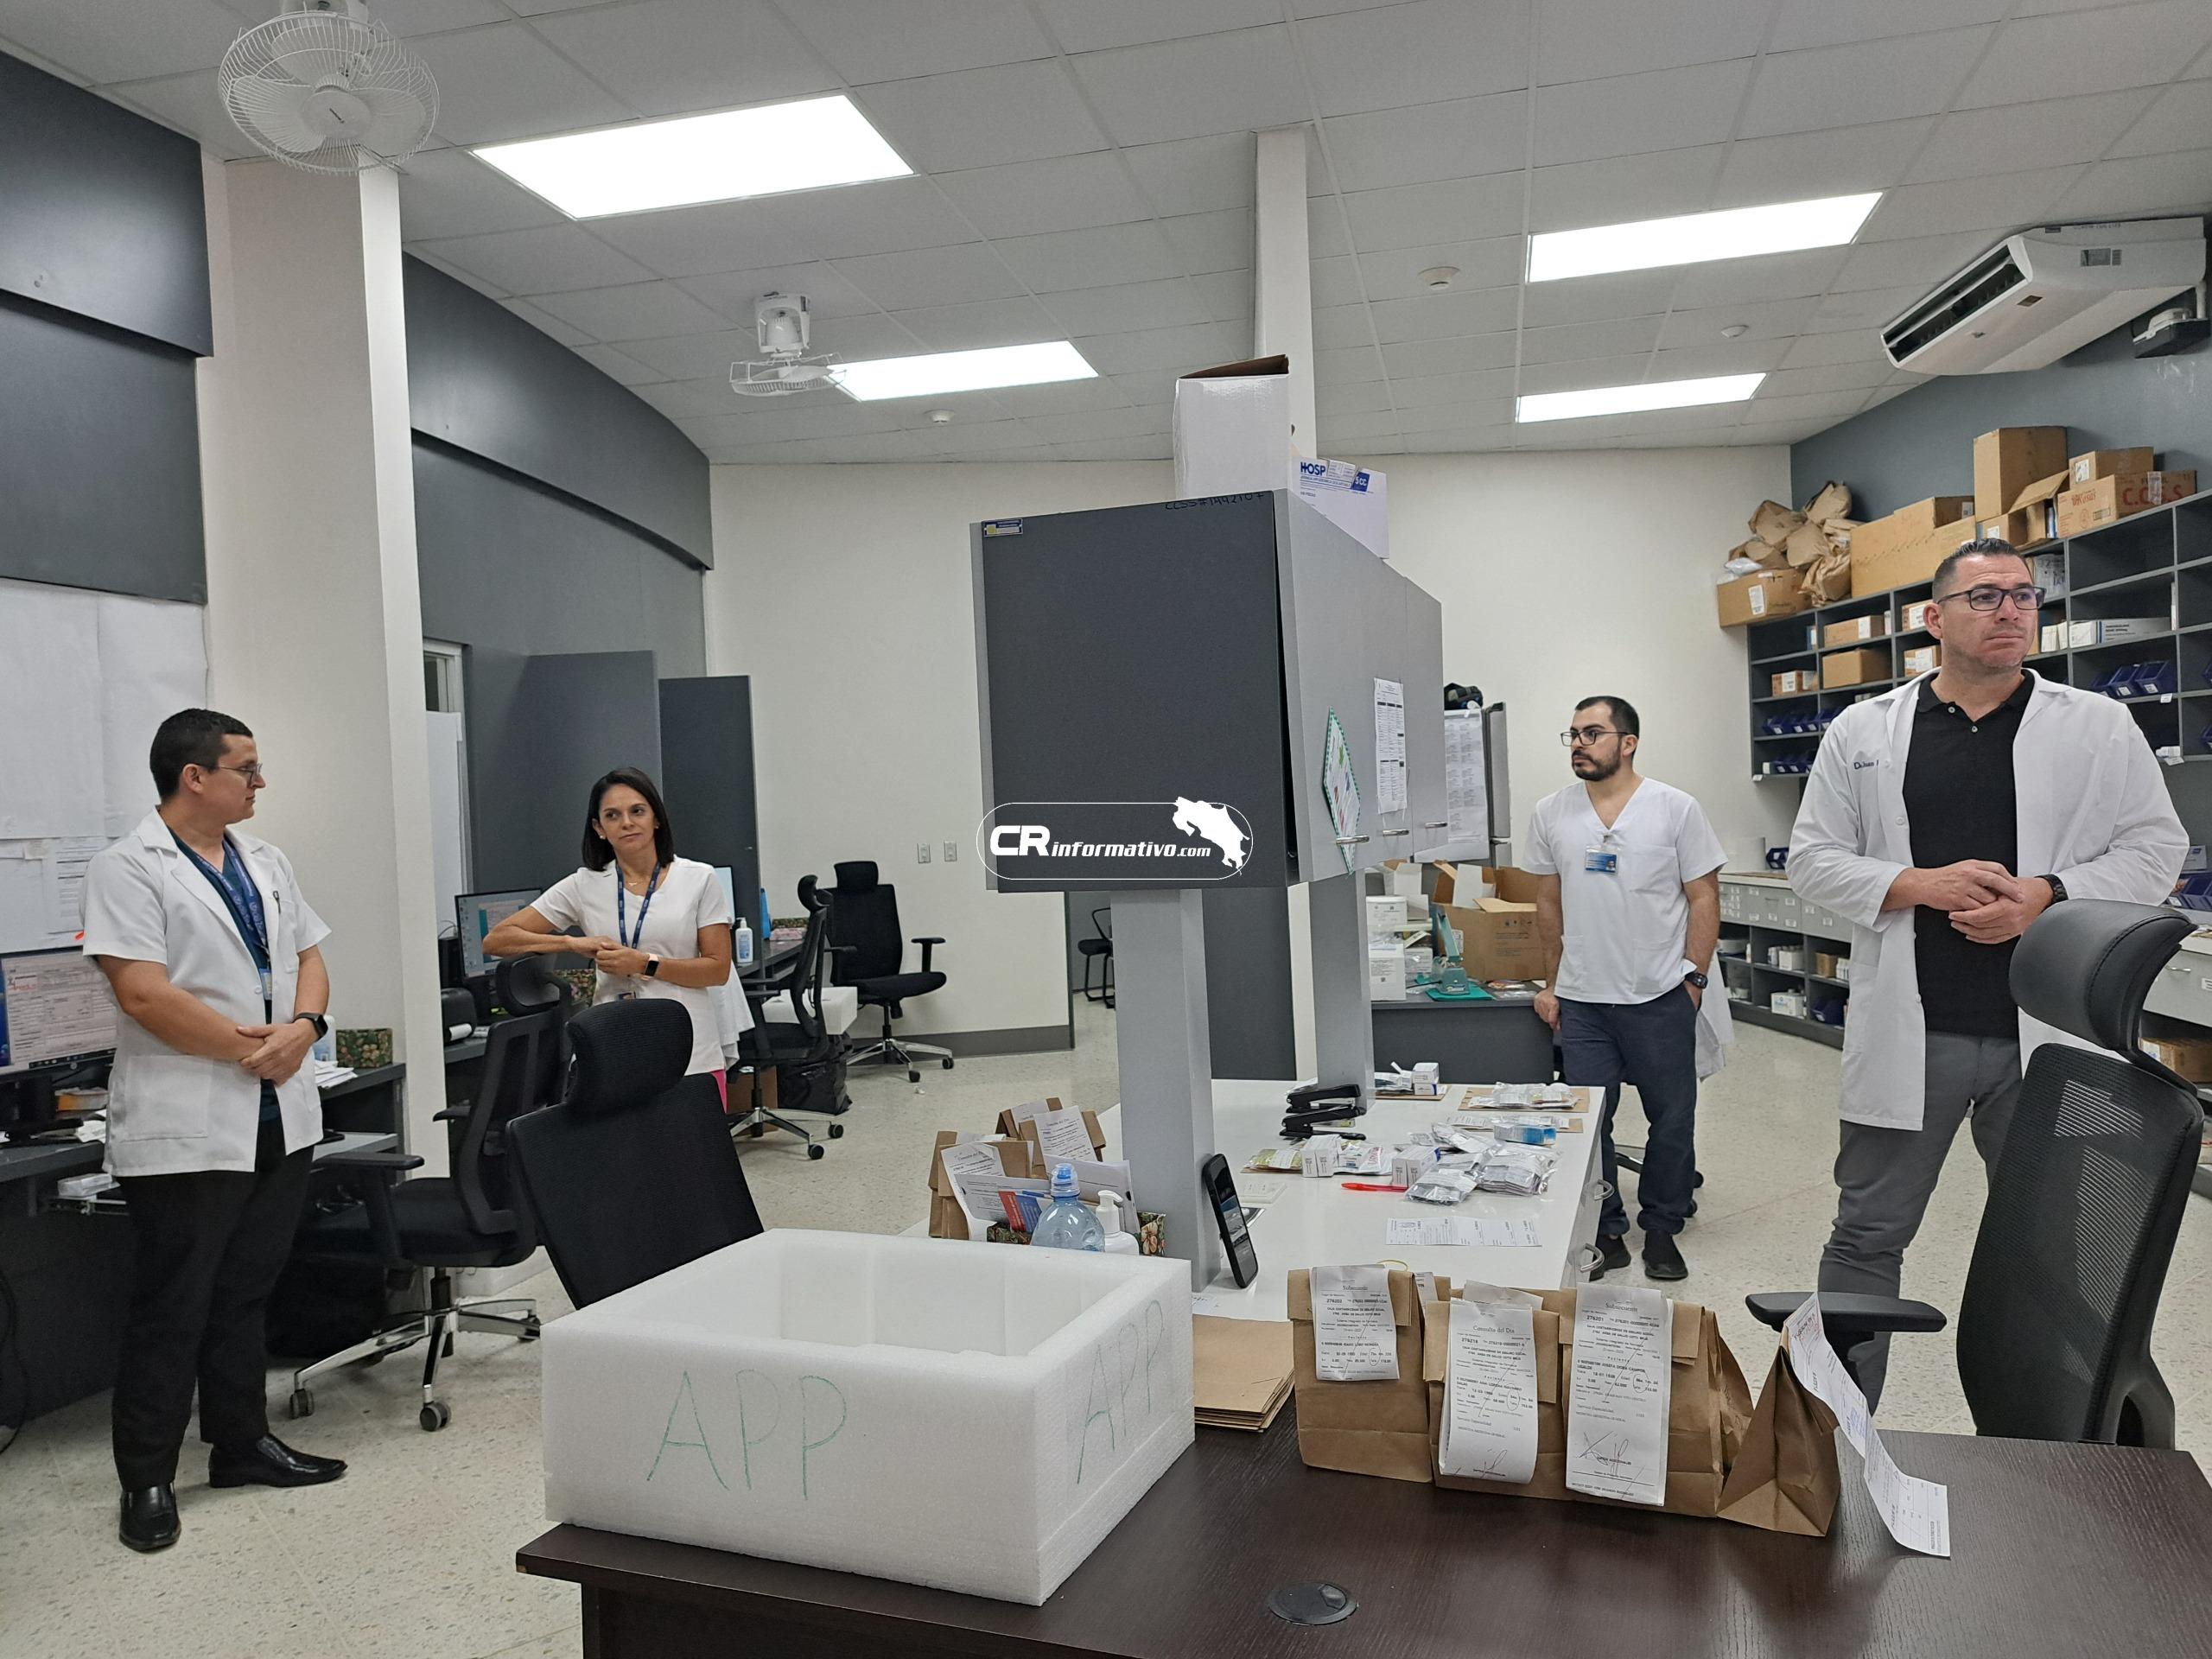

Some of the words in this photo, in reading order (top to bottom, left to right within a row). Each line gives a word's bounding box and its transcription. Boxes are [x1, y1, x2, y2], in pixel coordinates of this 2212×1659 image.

[1300, 461, 1326, 477] HOSP
[646, 1368, 847, 1501] APP
[1076, 1299, 1165, 1485] APP
